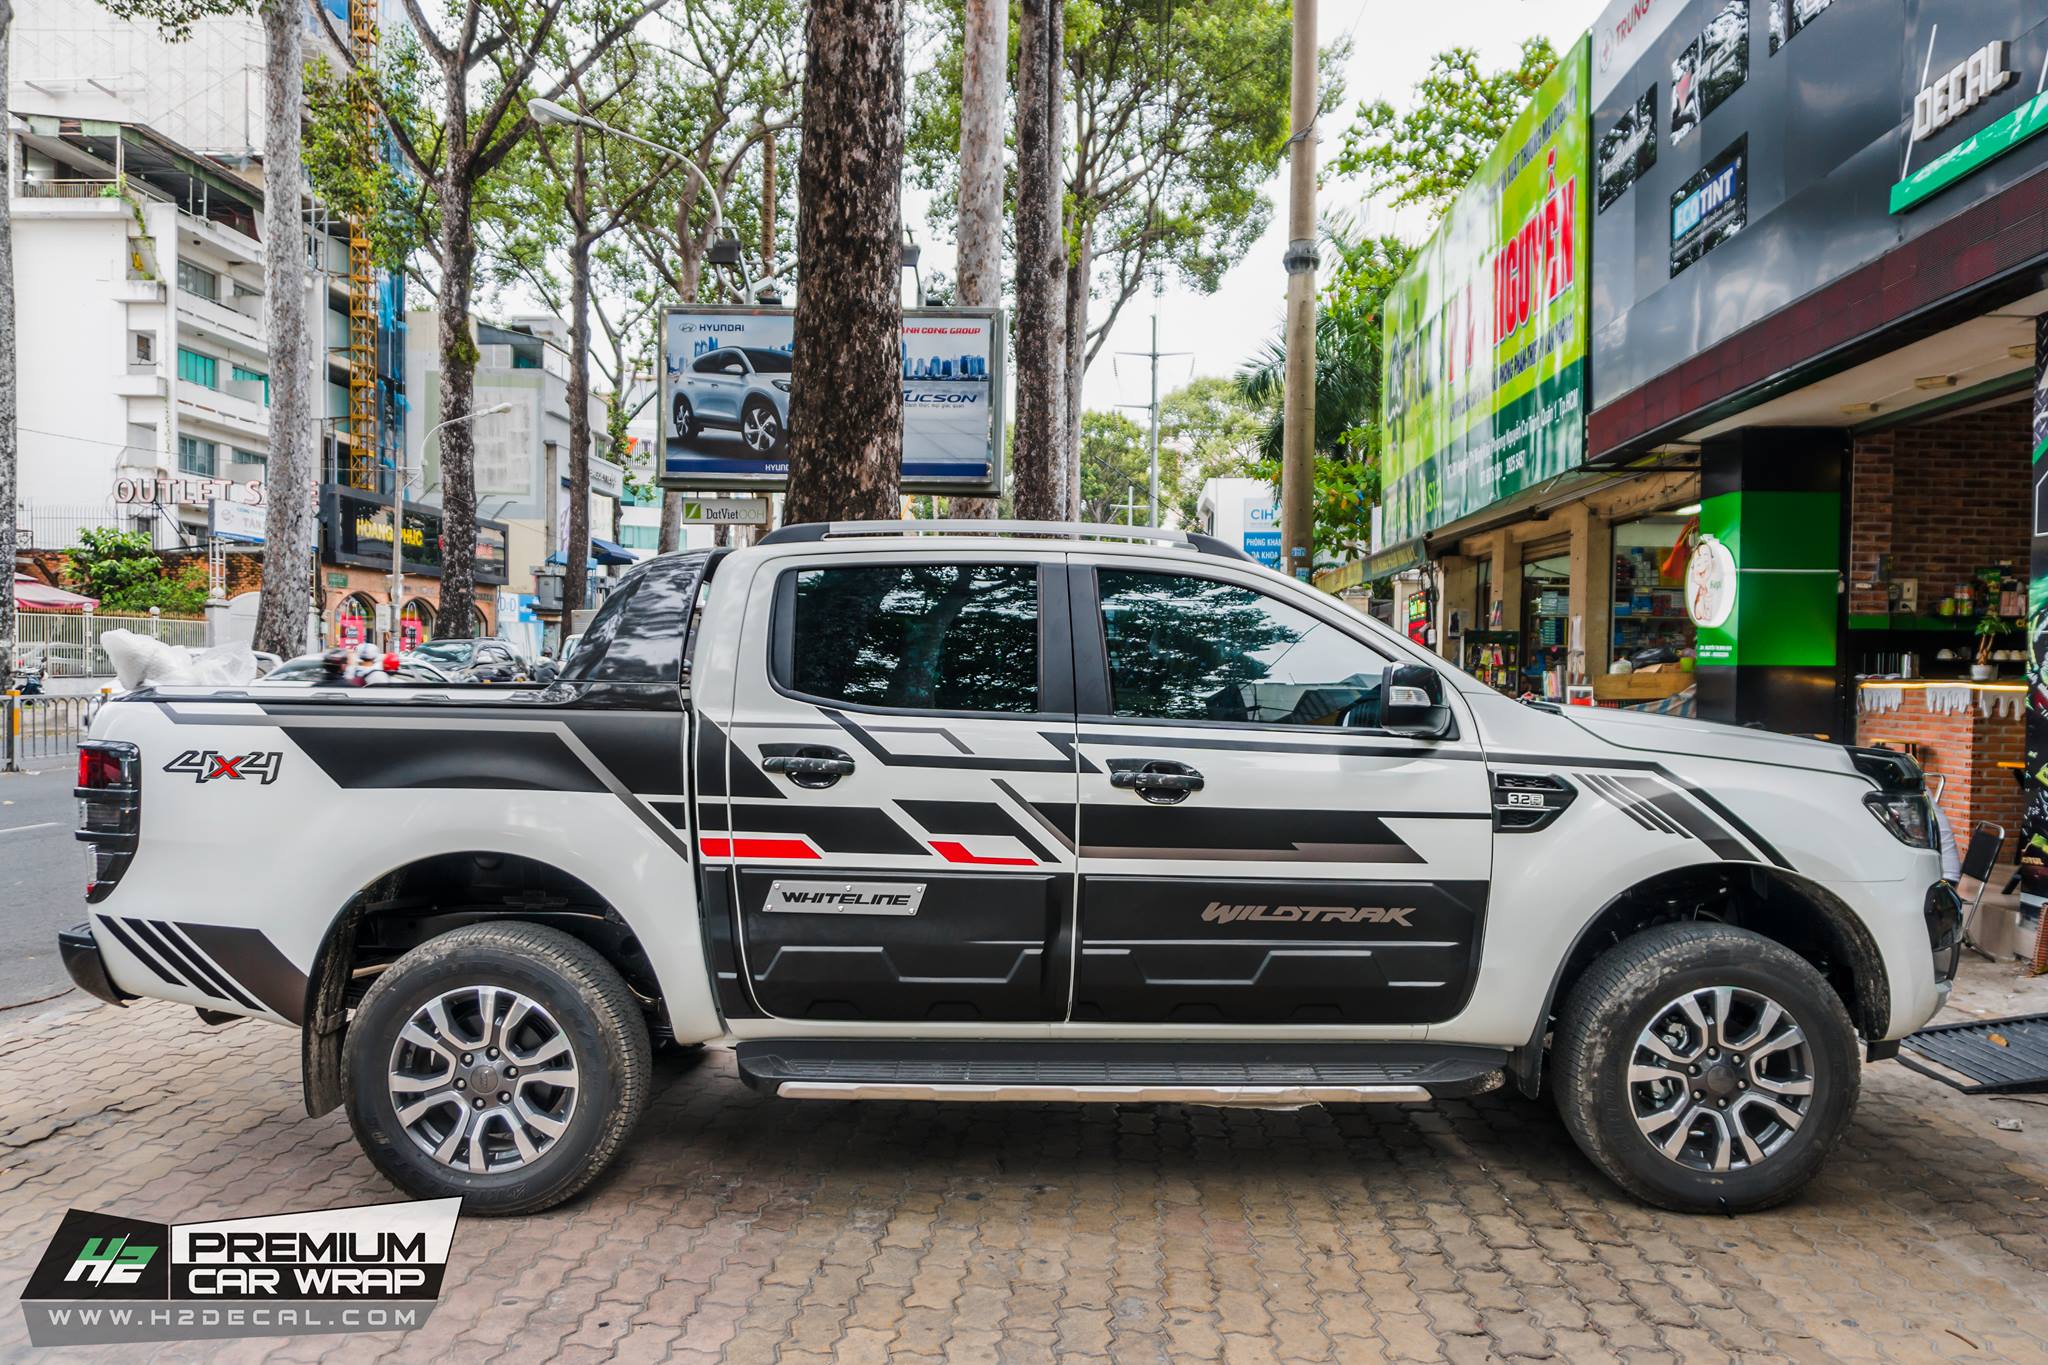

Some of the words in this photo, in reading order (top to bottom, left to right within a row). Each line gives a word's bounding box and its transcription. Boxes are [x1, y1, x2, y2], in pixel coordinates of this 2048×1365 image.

[1914, 40, 2010, 141] DECAL
[699, 324, 745, 332] HYUNDAI
[949, 327, 982, 335] GROUP
[112, 477, 234, 504] OUTLET
[781, 891, 912, 906] WHITELINE
[1201, 901, 1416, 928] WILDTRAK
